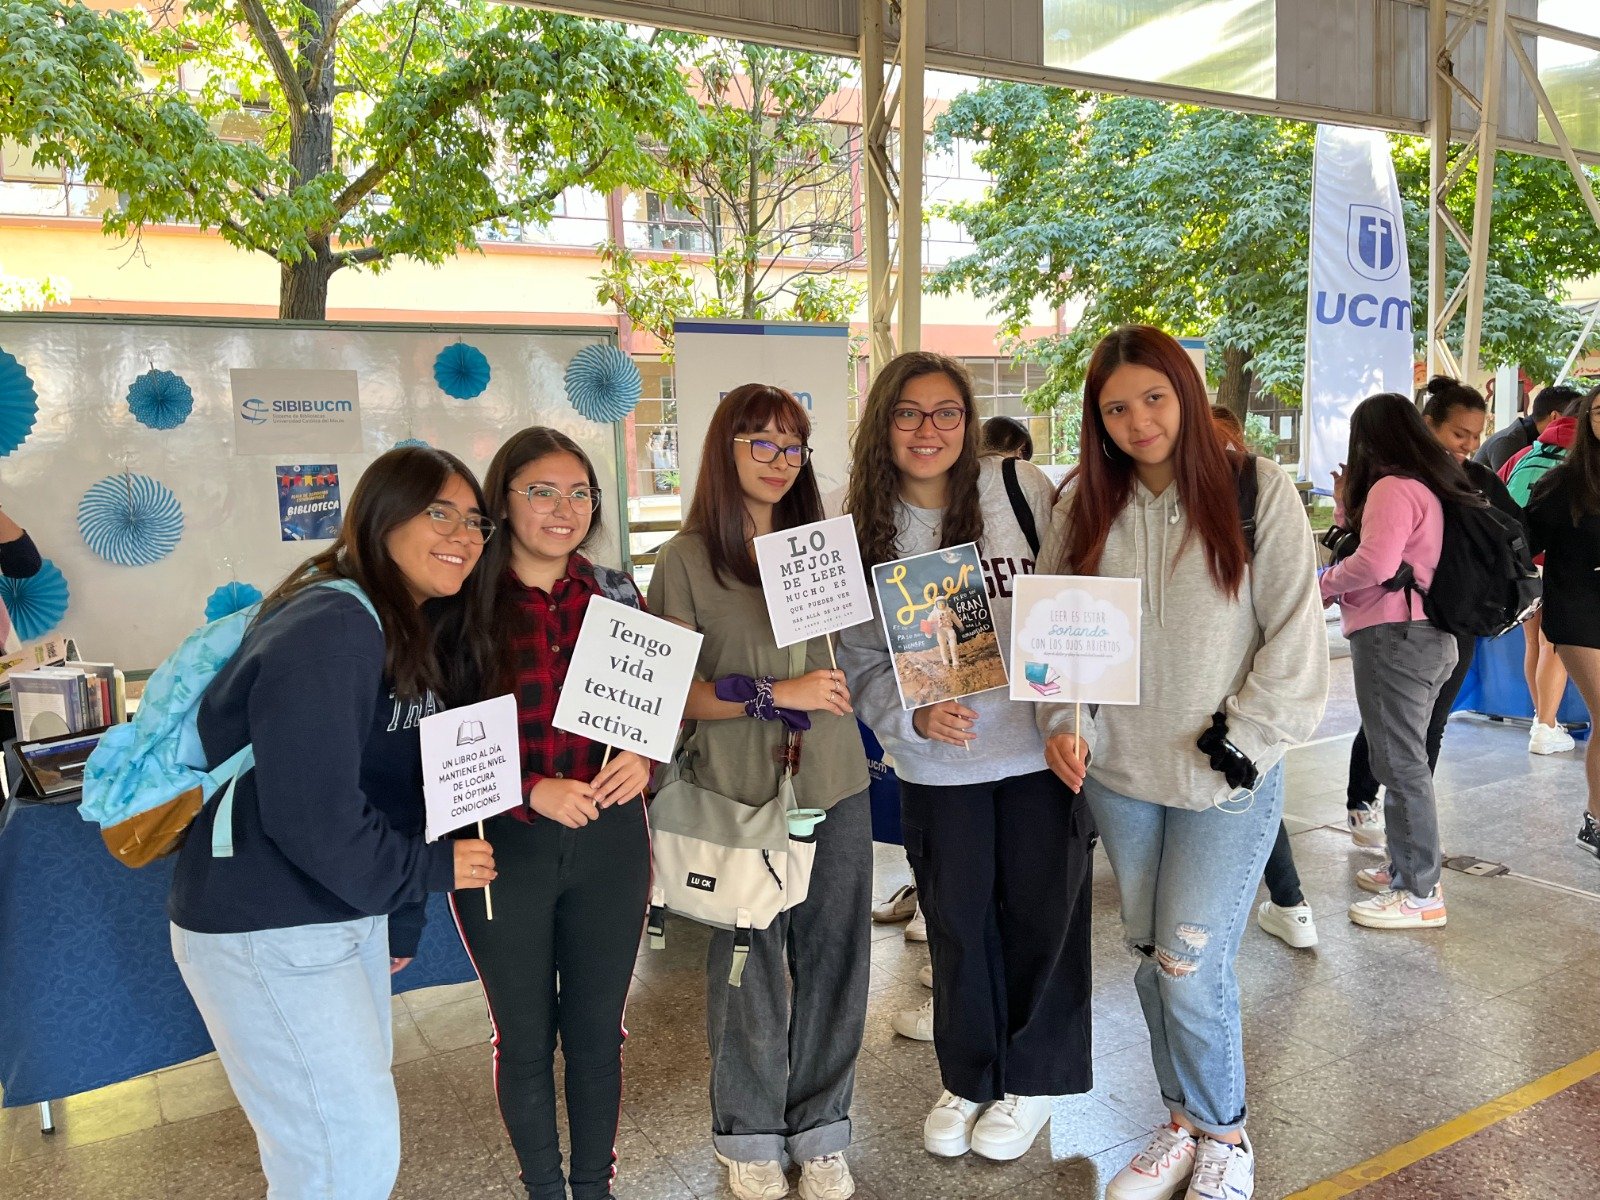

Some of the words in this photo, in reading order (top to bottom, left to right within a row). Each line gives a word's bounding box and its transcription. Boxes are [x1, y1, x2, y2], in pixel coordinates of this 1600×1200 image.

[287, 500, 339, 516] BIBLIOTECA
[787, 530, 826, 558] LO
[779, 550, 842, 577] MEJOR
[783, 577, 801, 591] DE
[811, 565, 846, 583] LEER
[786, 586, 825, 603] MUCHO
[834, 579, 847, 589] ES
[790, 604, 804, 615] QUE
[808, 596, 834, 608] PUEDES
[837, 591, 850, 599] VER
[886, 564, 974, 626] Leer
[956, 594, 984, 613] GRAN
[958, 608, 987, 622] SALTO
[1050, 610, 1067, 622] LEER
[1071, 610, 1080, 623] ES
[1083, 611, 1106, 623] ESTAR
[609, 618, 672, 657] Tengo
[1031, 638, 1046, 649] CON
[1049, 639, 1062, 650] LOS
[1065, 639, 1083, 651] OJOS
[1086, 639, 1121, 653] ABIERTOS
[609, 655, 654, 682] vida
[584, 677, 663, 717] textual
[577, 710, 648, 744] activa.
[442, 758, 453, 770] UN
[454, 752, 478, 766] LIBRO
[479, 750, 488, 759] AL
[489, 743, 502, 755] DÍA
[438, 764, 478, 784] MANTIENE
[478, 761, 487, 771] EL
[487, 755, 507, 768] NIVEL
[453, 780, 464, 792] DE
[465, 771, 496, 788] LOCURA
[450, 793, 501, 817] CONDICIONES
[453, 793, 463, 804] EN
[465, 782, 497, 801] ÓPTIMAS
